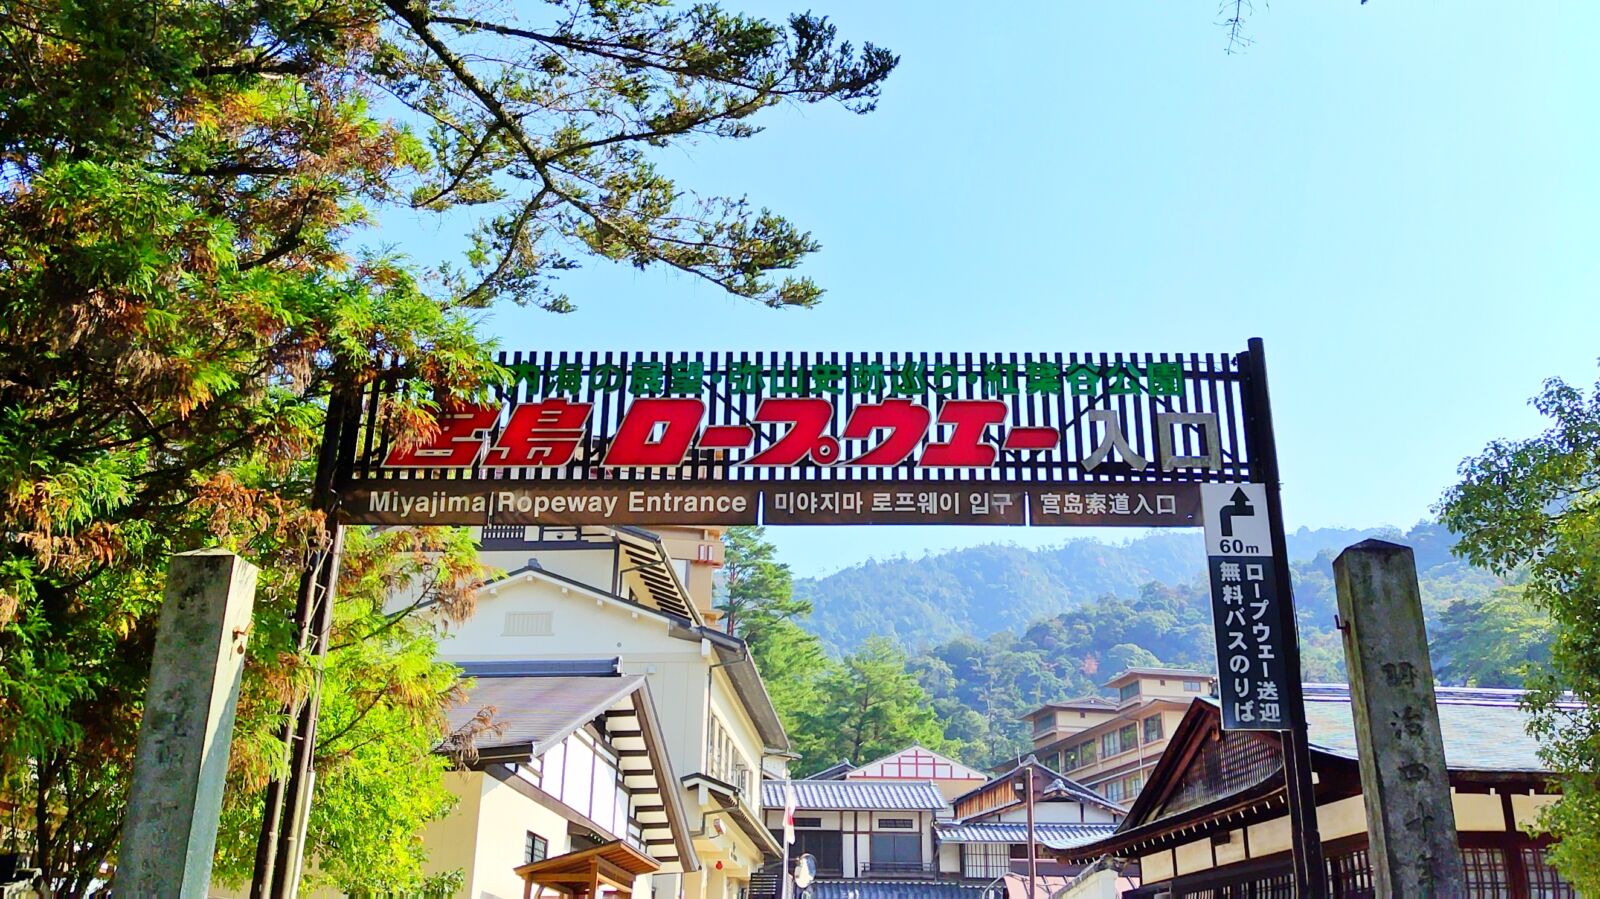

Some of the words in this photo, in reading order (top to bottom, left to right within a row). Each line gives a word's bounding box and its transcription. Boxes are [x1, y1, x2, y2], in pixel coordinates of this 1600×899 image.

[484, 360, 1185, 397] 内海の展望・弥山史跡巡り・紅葉谷公園
[369, 491, 486, 518] Miyajima
[498, 491, 618, 518] Ropeway
[628, 491, 747, 512] Entrance
[774, 492, 863, 514] 미야지마
[871, 492, 960, 514] 로프웨이
[969, 492, 1014, 515] 입구
[1040, 493, 1177, 516] 宫岛索道入口
[1219, 561, 1255, 723] 無料バスのりば
